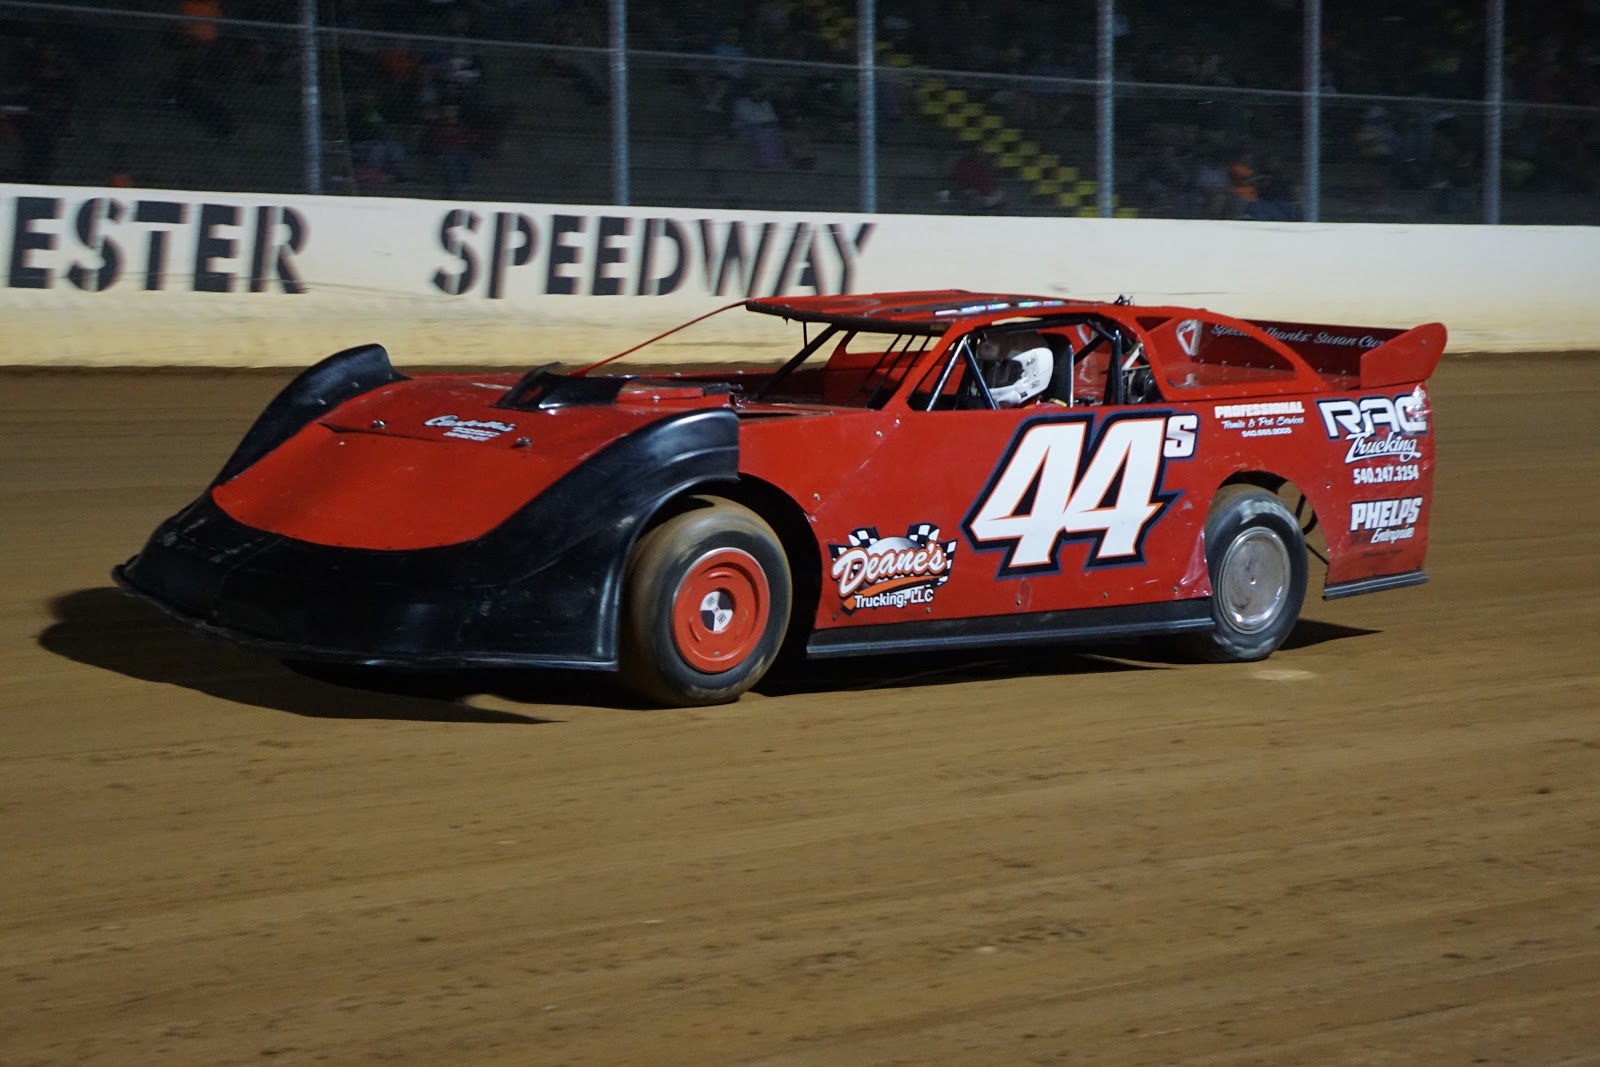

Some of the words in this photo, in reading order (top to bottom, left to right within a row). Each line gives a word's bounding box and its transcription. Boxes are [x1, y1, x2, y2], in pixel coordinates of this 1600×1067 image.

[6, 196, 311, 294] ESTER
[430, 208, 877, 299] SPEEDWAY
[1313, 331, 1358, 346] Susan
[1214, 401, 1305, 418] PROFESSIONAL
[1317, 395, 1427, 438] RAC
[1344, 431, 1422, 464] Trucking
[1352, 464, 1420, 485] 540.247.3254
[1350, 496, 1423, 531] PHELPS
[831, 541, 946, 598] Deane's
[854, 592, 908, 608] Trucking,
[910, 588, 934, 604] LLC
